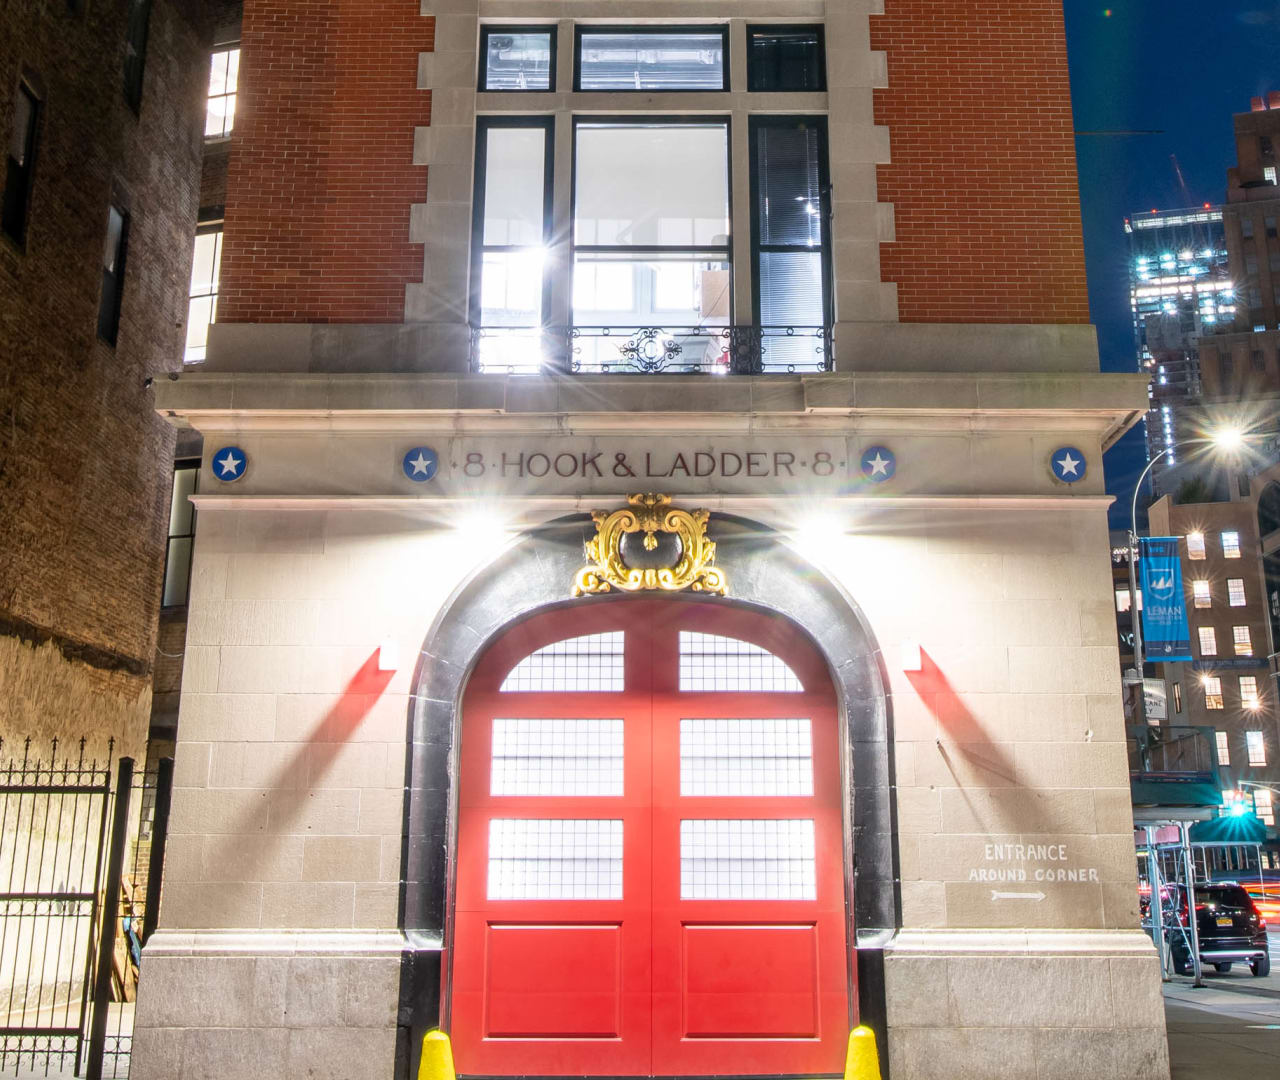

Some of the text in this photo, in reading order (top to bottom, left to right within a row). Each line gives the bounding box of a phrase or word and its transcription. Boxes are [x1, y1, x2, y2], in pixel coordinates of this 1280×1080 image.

[463, 452, 835, 478] 8 HOOK & LADDER 8
[984, 843, 1068, 860] ENTRANCE
[969, 868, 1099, 883] AROUND CORNER
